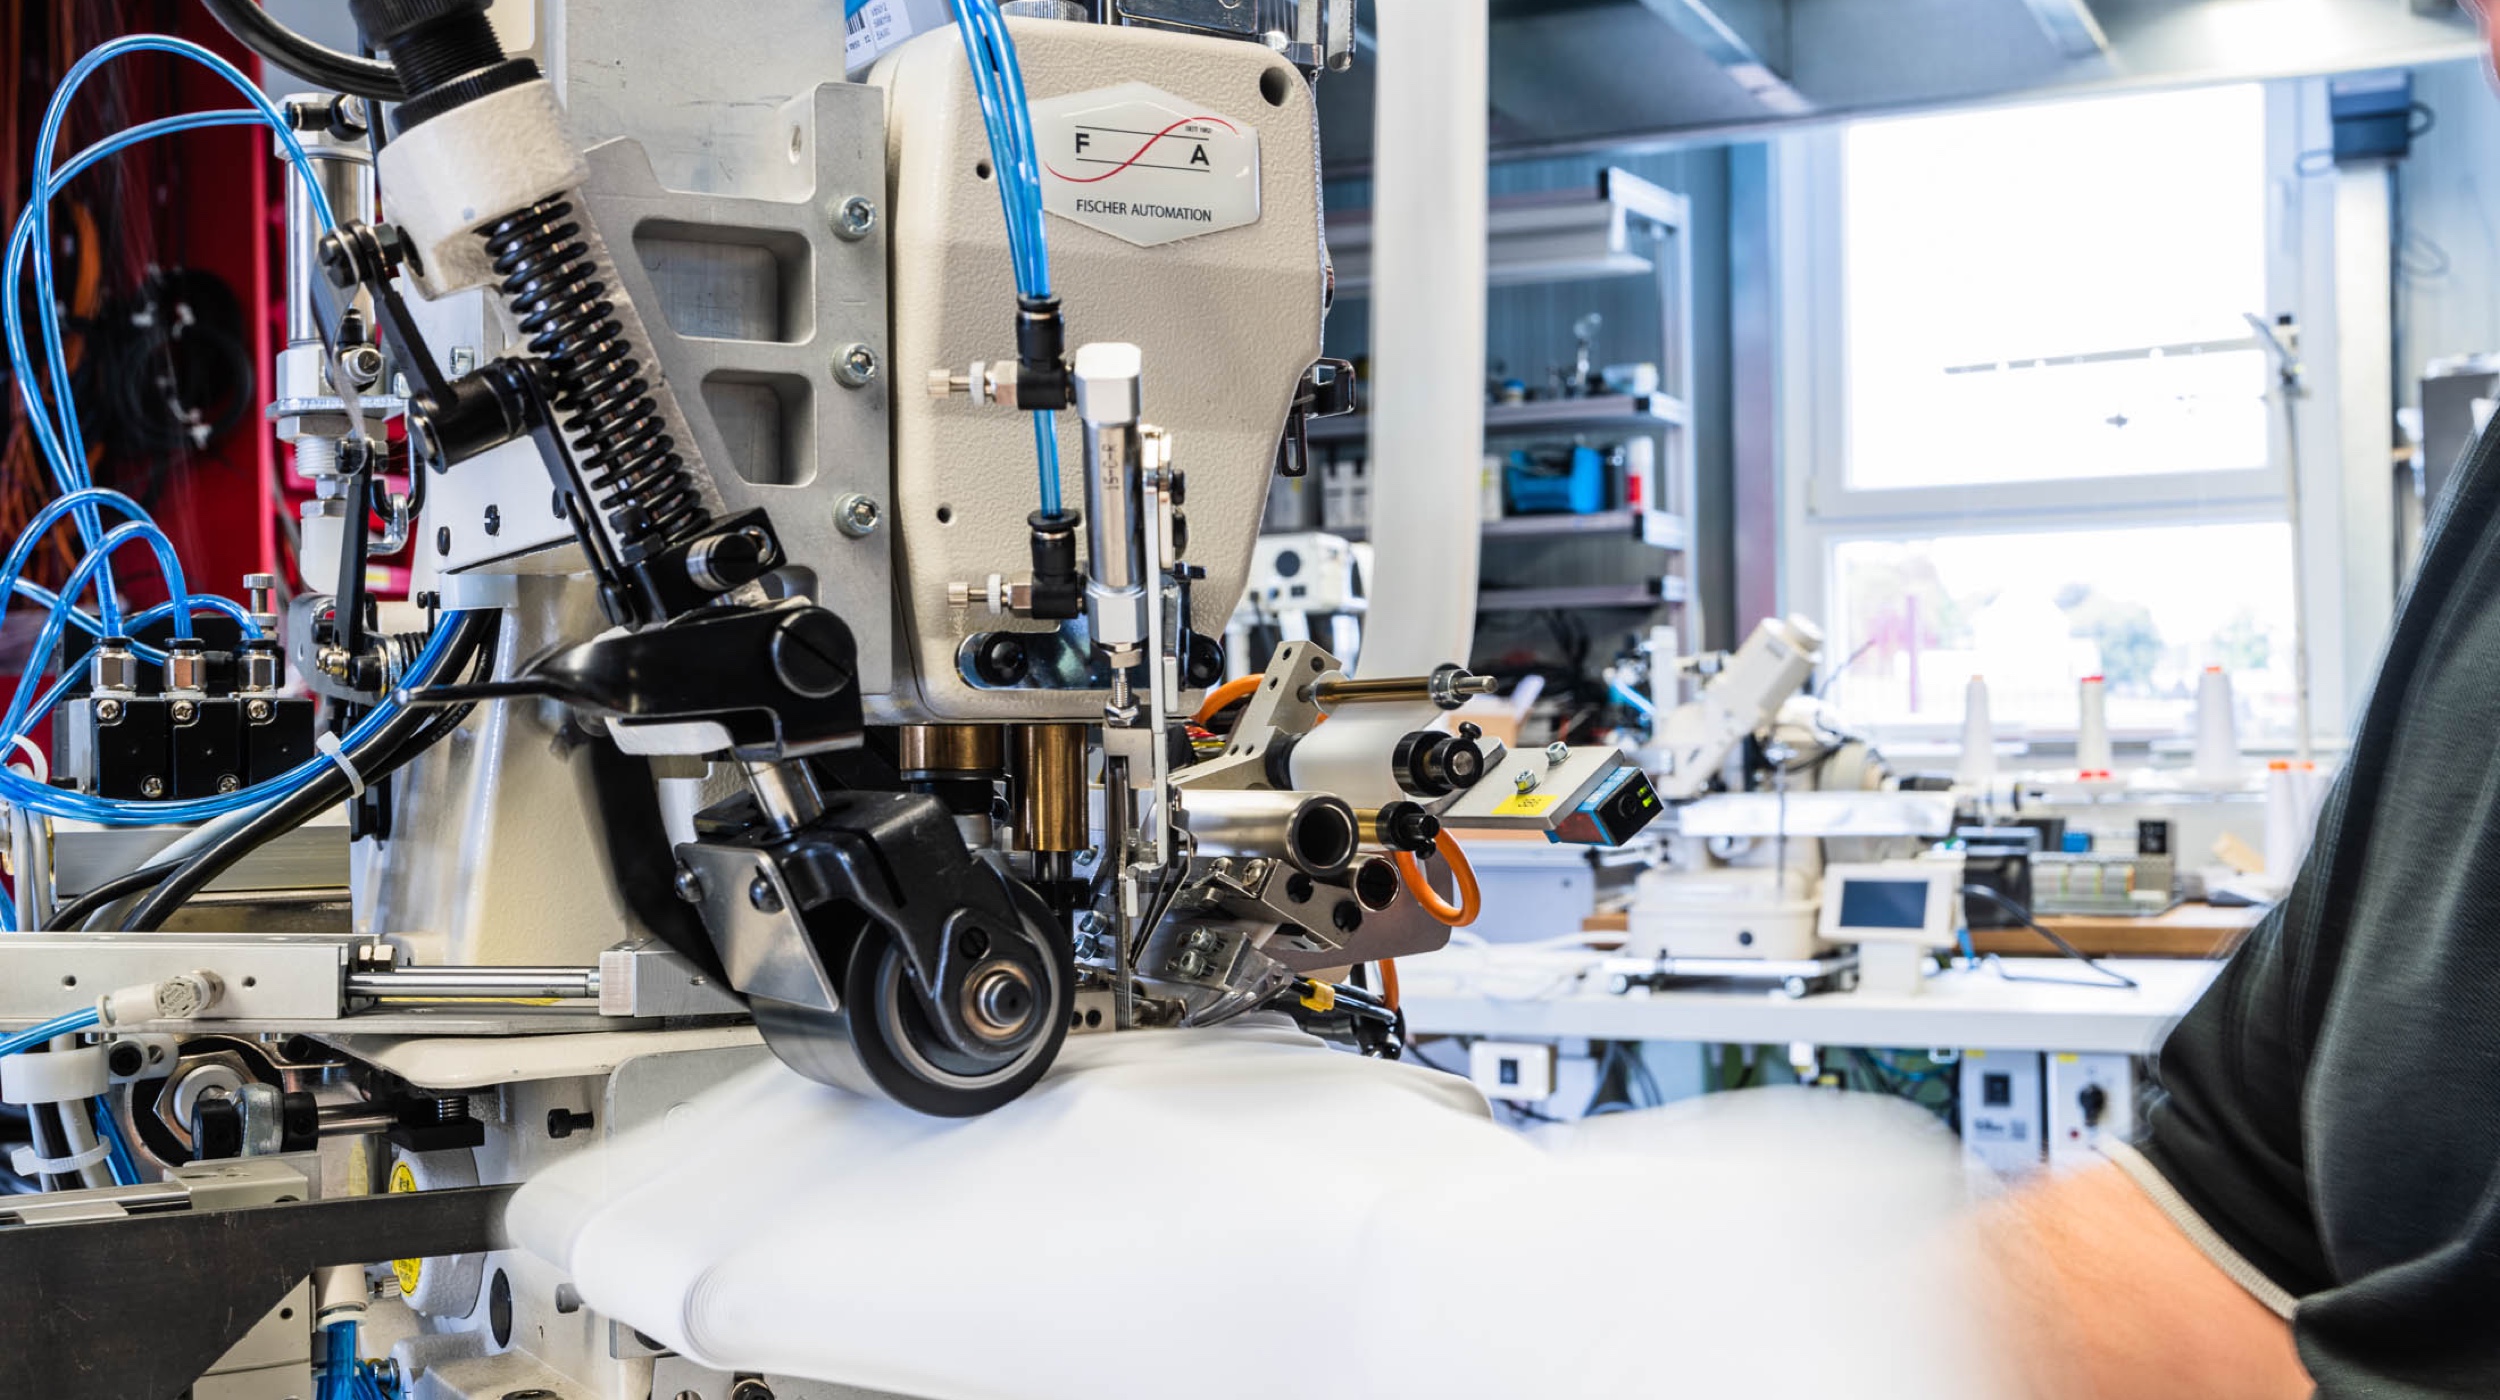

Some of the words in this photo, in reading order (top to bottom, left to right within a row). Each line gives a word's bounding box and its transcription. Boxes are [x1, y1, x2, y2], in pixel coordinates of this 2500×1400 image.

[1075, 132, 1090, 154] F
[1190, 143, 1210, 166] A
[1076, 199, 1127, 215] FISCHER
[1131, 203, 1212, 222] AUTOMATION
